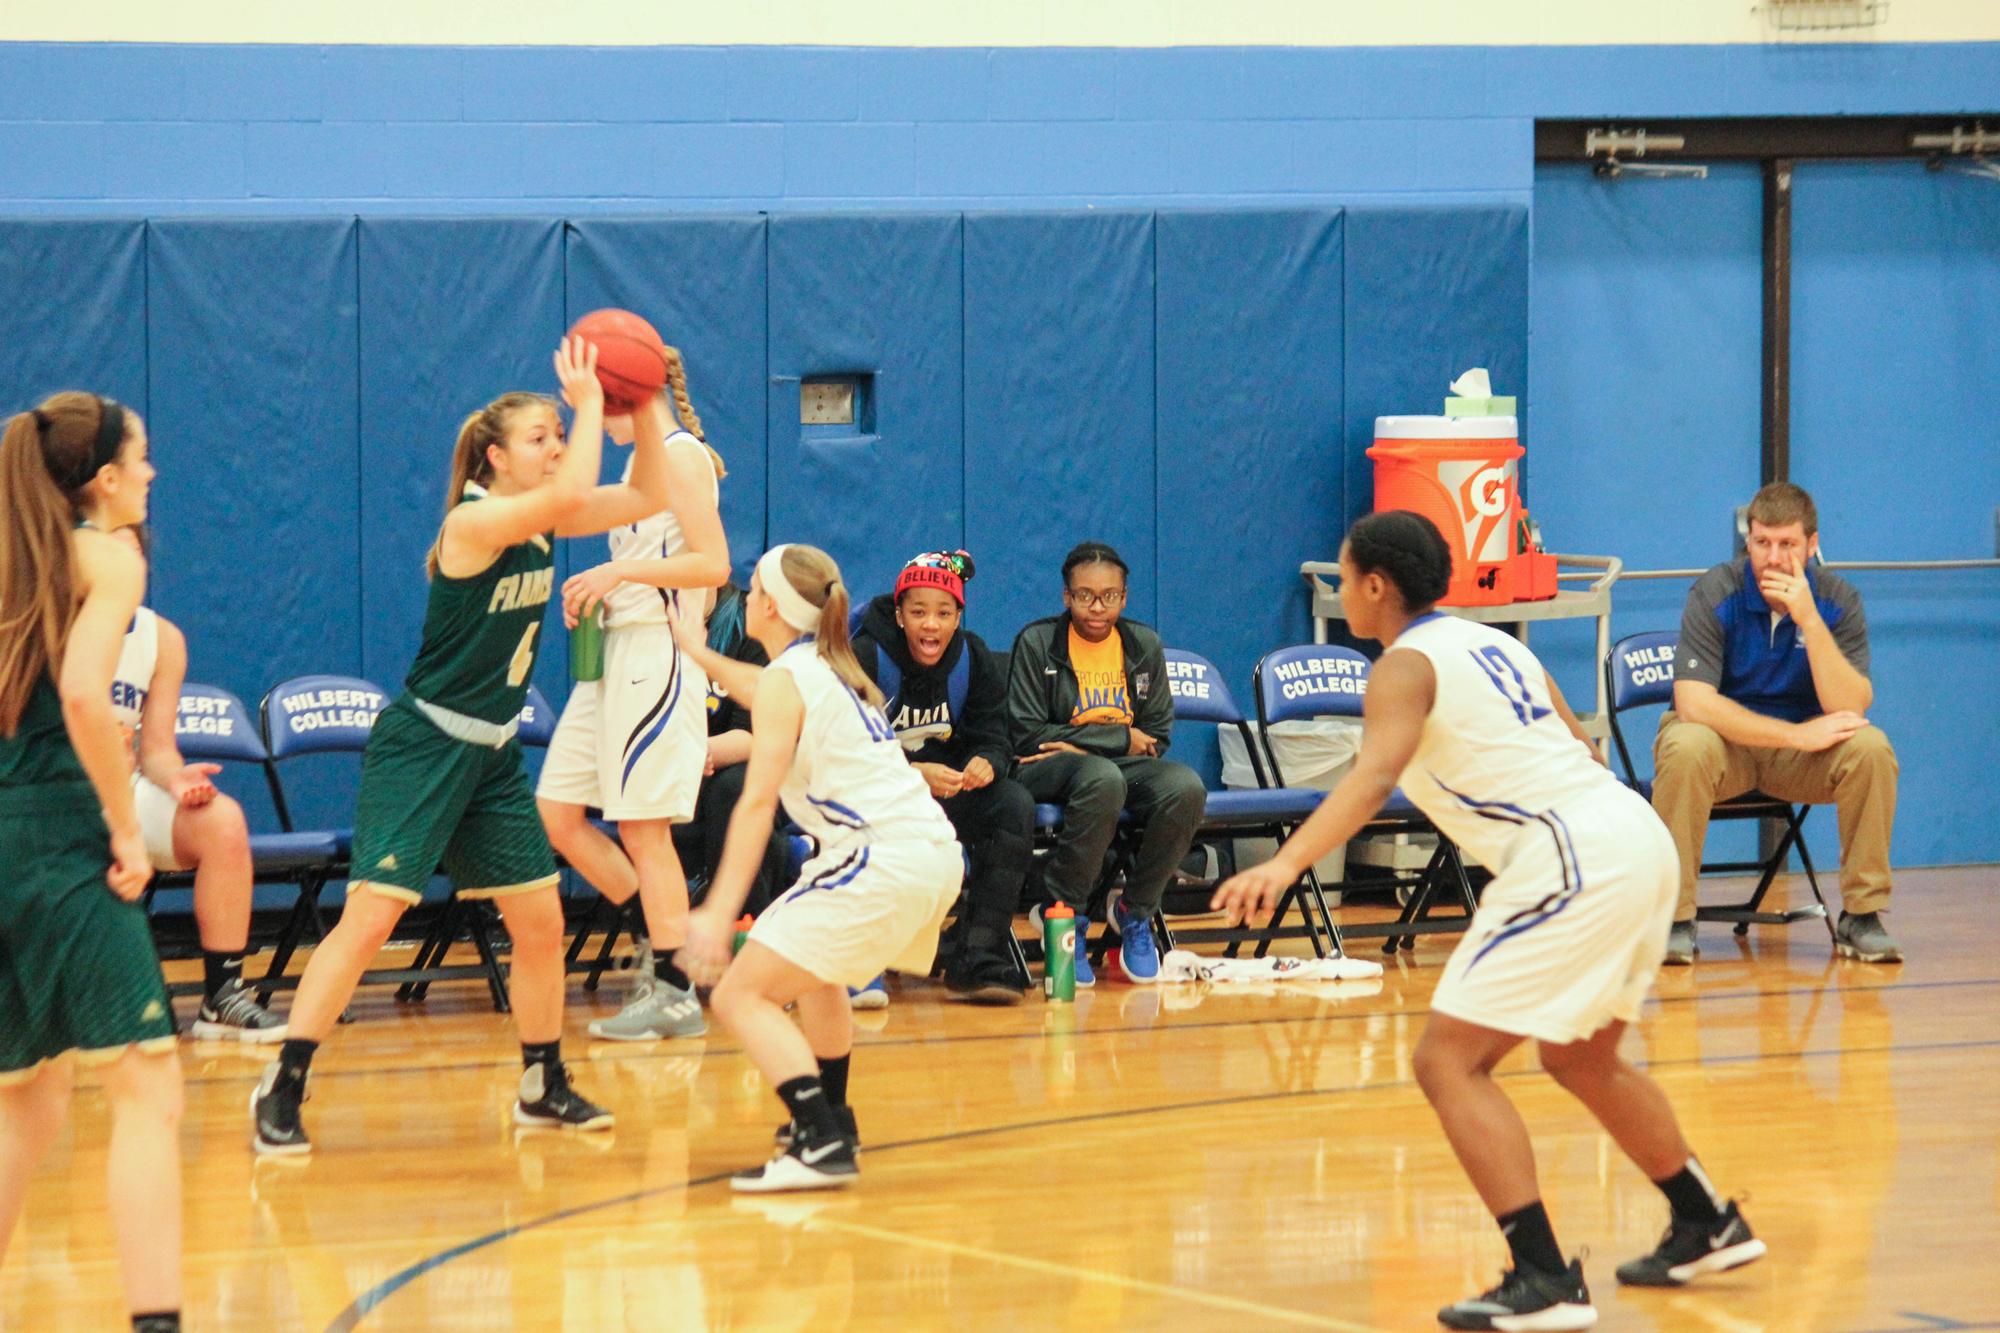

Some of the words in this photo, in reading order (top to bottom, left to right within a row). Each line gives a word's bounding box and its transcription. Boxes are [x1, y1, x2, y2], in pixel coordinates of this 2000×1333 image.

[1470, 467, 1505, 517] G
[904, 570, 957, 590] BELIEVE
[506, 621, 540, 687] 4
[1624, 645, 1677, 669] HILB
[1166, 661, 1207, 680] ERT
[1274, 658, 1366, 681] HILBERT
[111, 680, 148, 713] ERT
[1168, 680, 1209, 699] EGE
[1282, 676, 1368, 700] COLLEGE
[177, 696, 232, 716] ERT
[282, 690, 382, 714] HILBERT
[1073, 686, 1127, 718] AWK
[175, 715, 234, 737] LEGE
